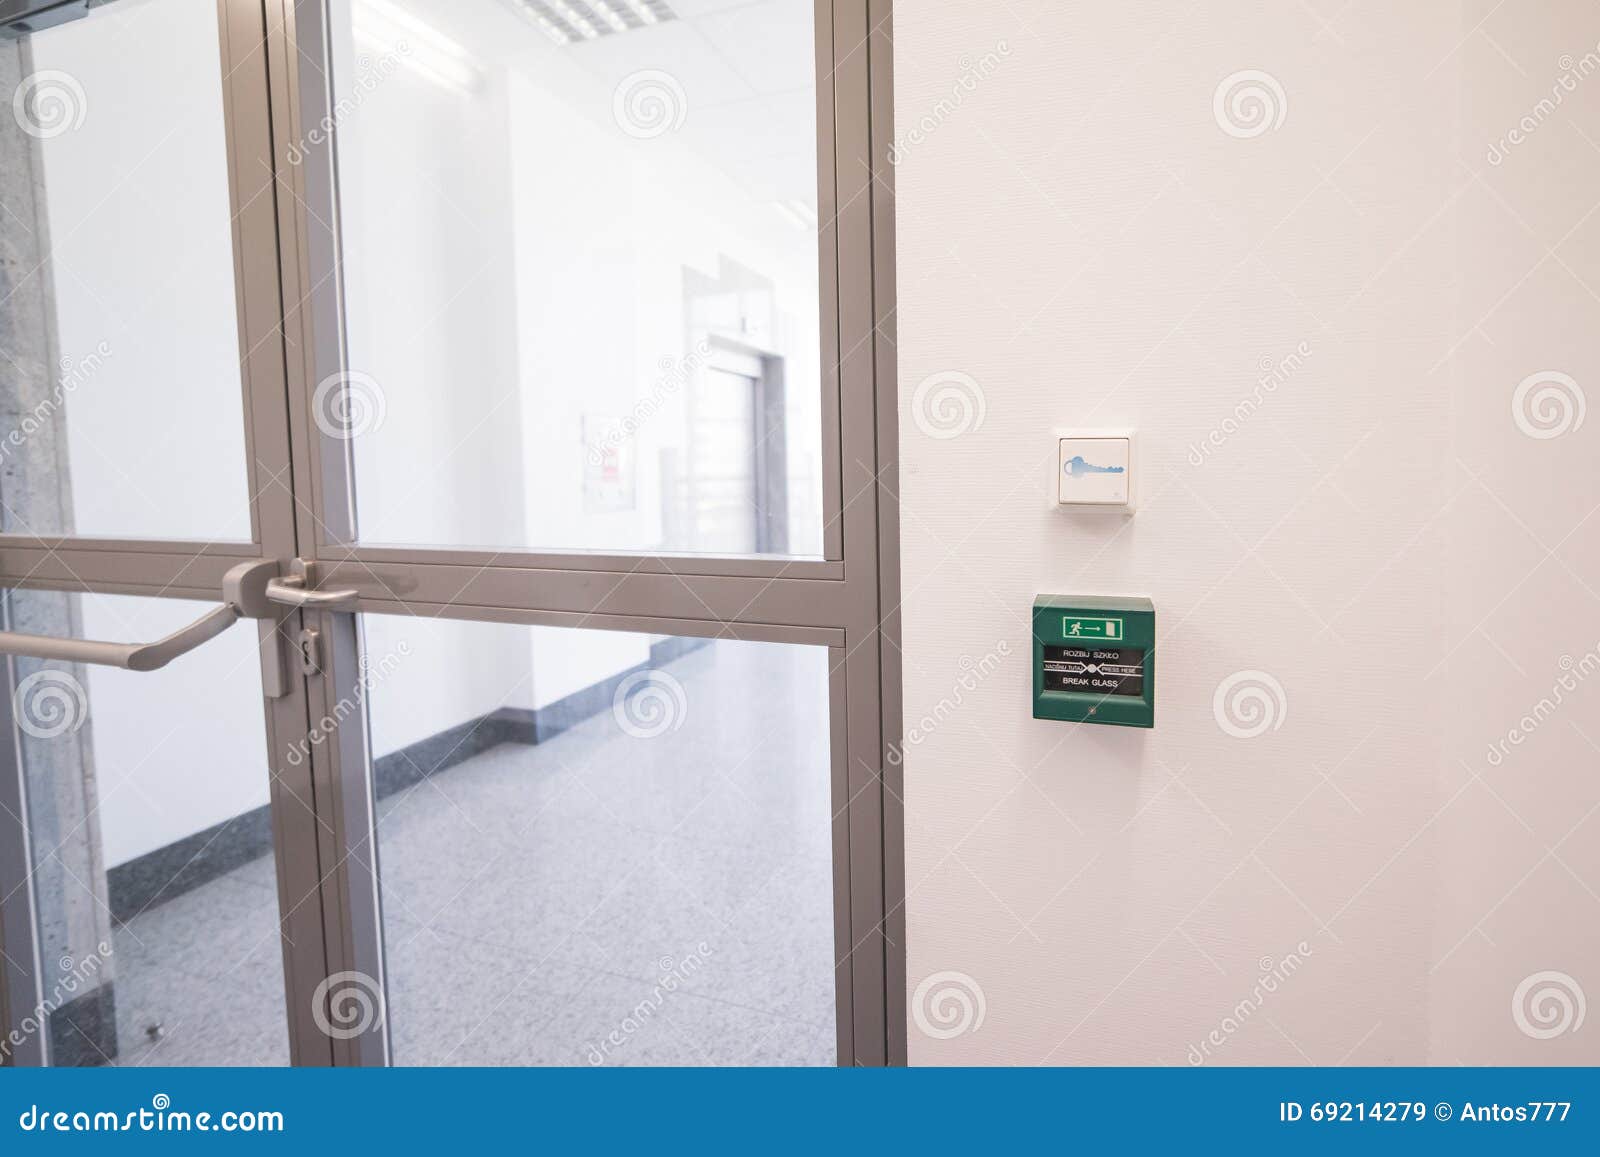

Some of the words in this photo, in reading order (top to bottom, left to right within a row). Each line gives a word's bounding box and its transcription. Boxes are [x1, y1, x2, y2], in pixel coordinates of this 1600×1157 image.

[1063, 649, 1090, 658] ROZBIJ
[1093, 651, 1119, 660] SZKŁO
[1062, 677, 1089, 686] BREAK
[1092, 679, 1118, 688] GLASS
